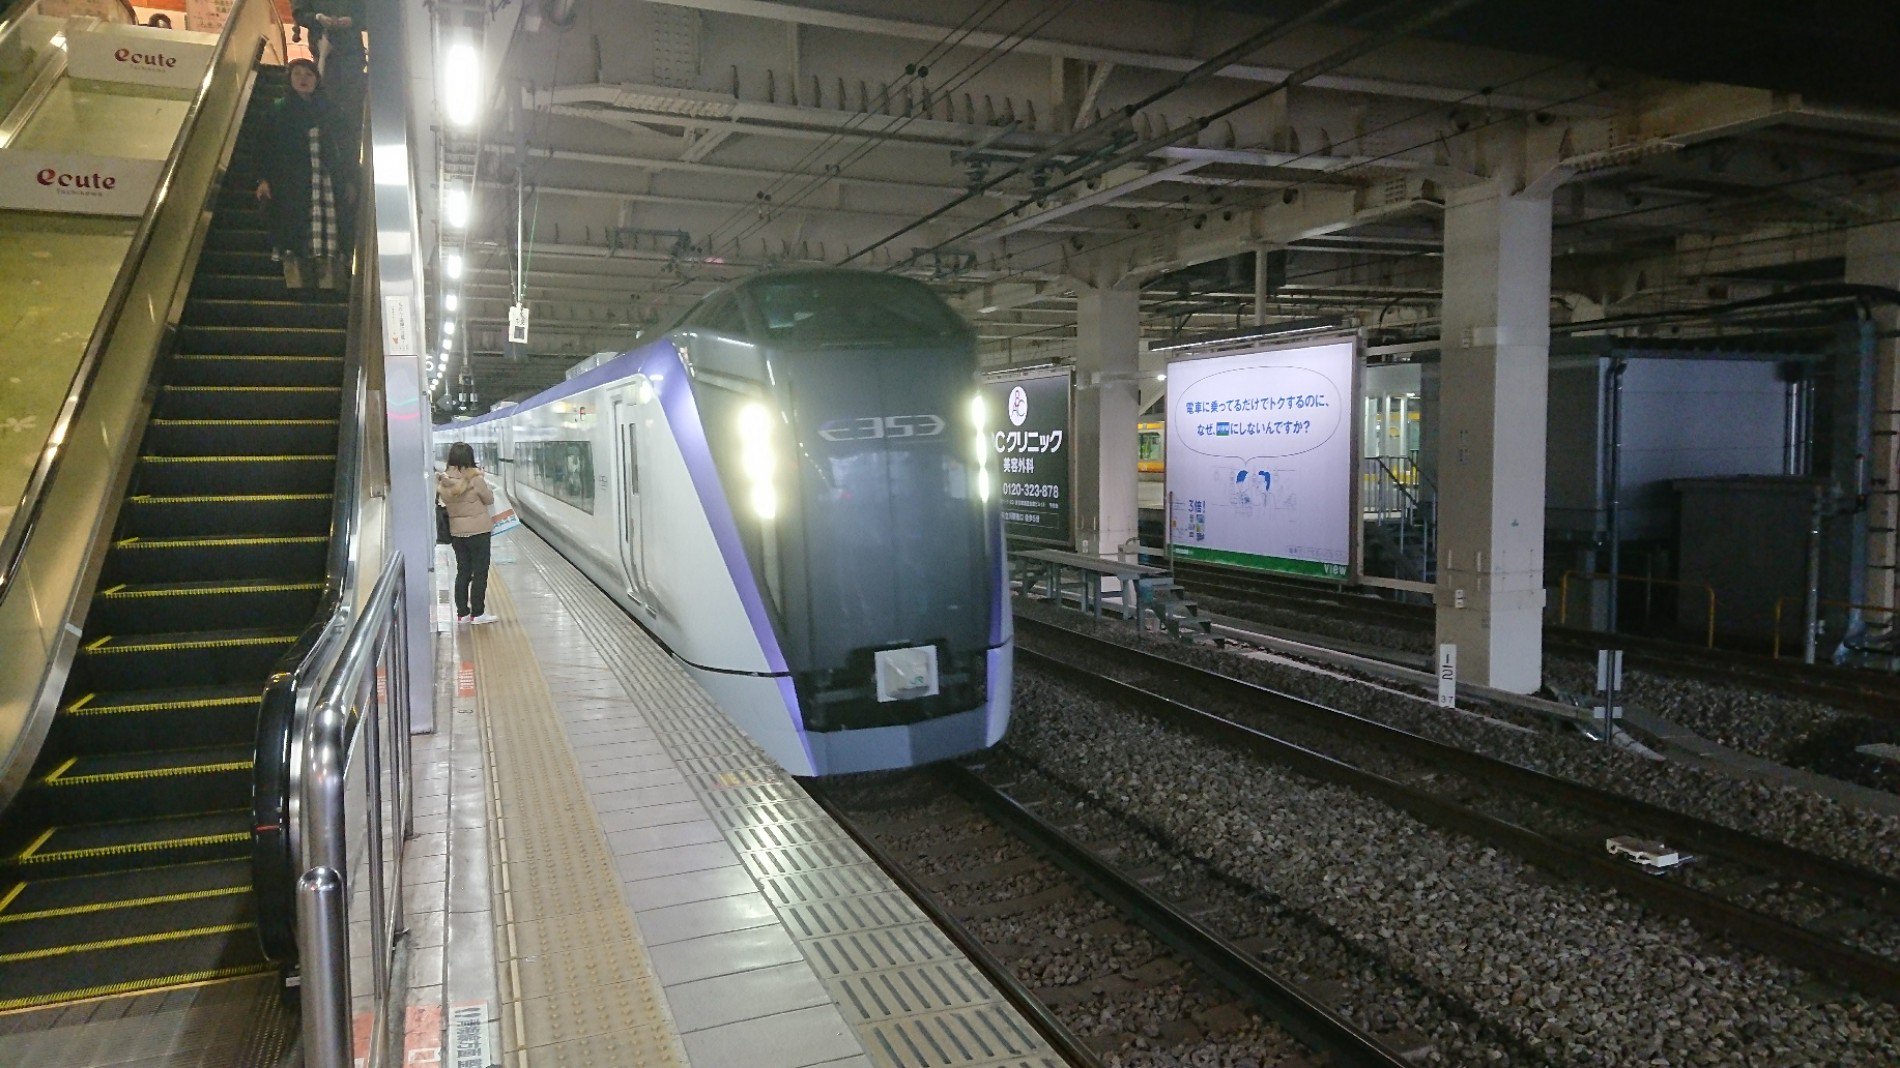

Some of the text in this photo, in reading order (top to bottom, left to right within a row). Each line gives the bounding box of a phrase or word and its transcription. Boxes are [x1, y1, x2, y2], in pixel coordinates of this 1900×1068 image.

[114, 48, 177, 67] ecute
[37, 168, 116, 190] ecute
[1185, 394, 1329, 415] 電車に乗ってるだけでトクするのに、
[818, 414, 946, 442] E353
[993, 430, 1063, 453] Cクリニック
[1003, 457, 1034, 473] 美容外科
[1003, 482, 1059, 499] 0120-323-878
